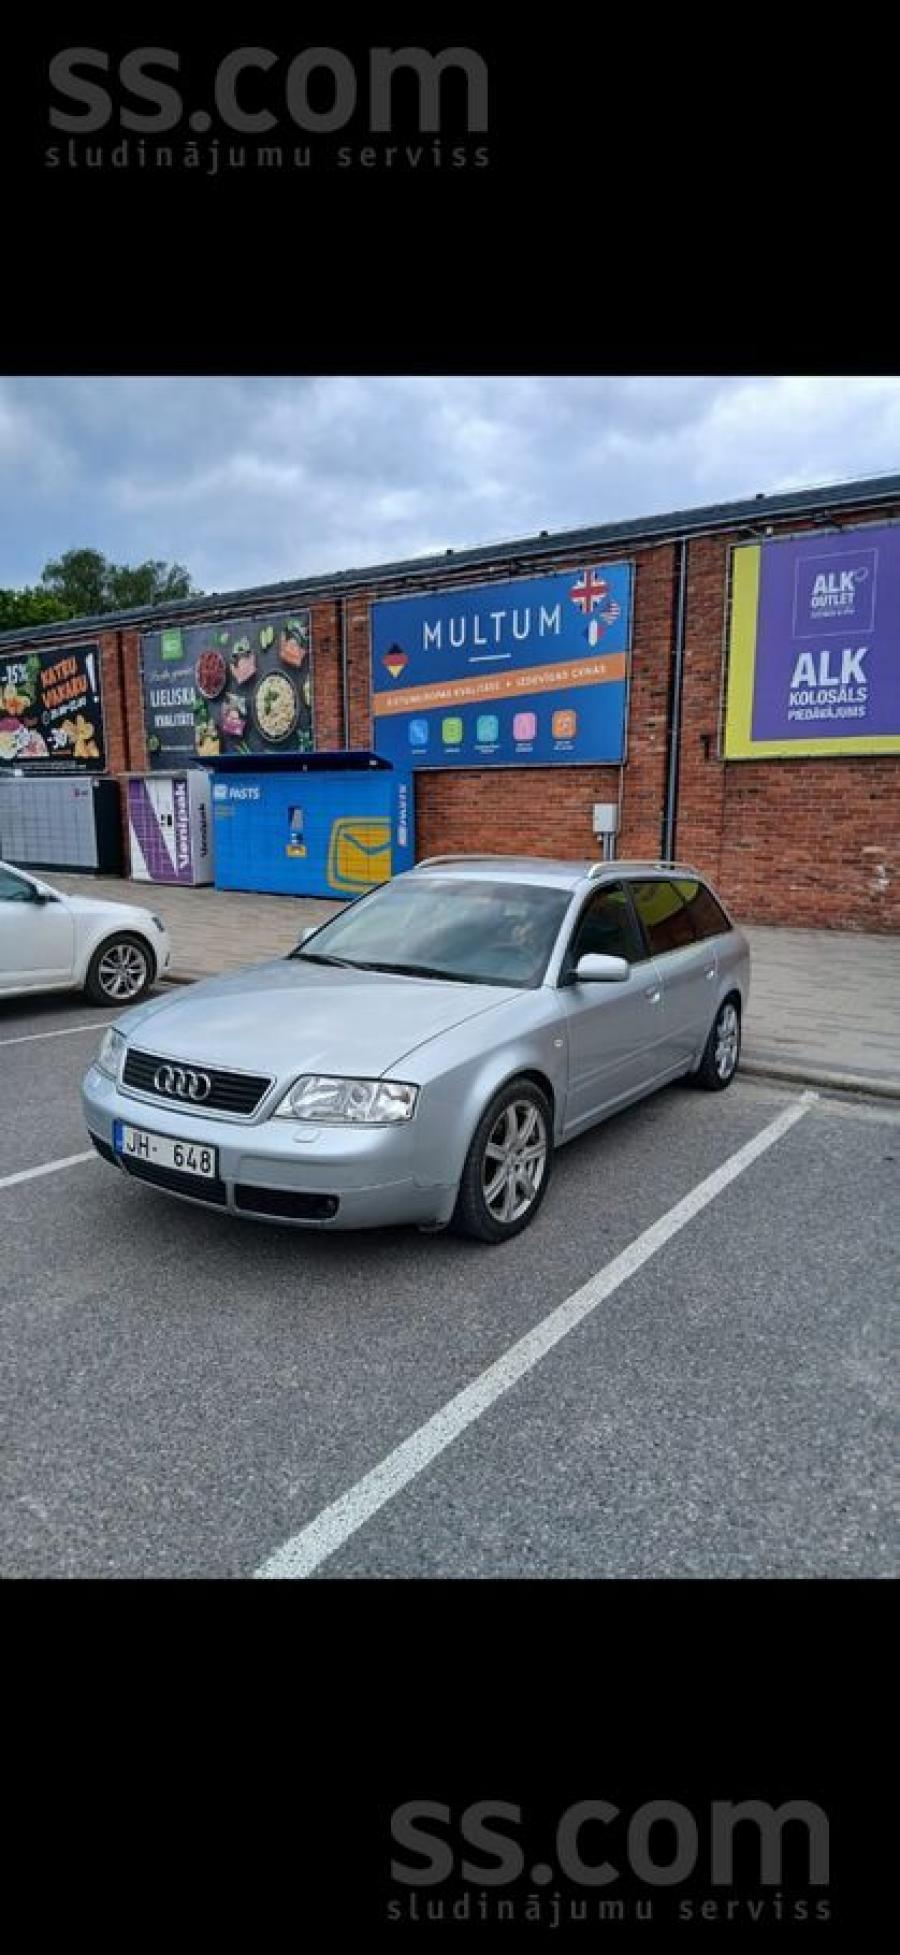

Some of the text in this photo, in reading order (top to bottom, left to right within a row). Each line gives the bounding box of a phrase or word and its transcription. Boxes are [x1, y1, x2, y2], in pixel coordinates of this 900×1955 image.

[814, 571, 855, 594] ALK
[811, 593, 855, 608] OUTLET
[423, 604, 561, 650] MULTUM
[790, 648, 868, 687] ALK
[150, 686, 196, 707] LIELISKA
[789, 685, 867, 706] KOLOSĀLS
[175, 781, 188, 869] Venipak
[173, 1144, 211, 1174] 648
